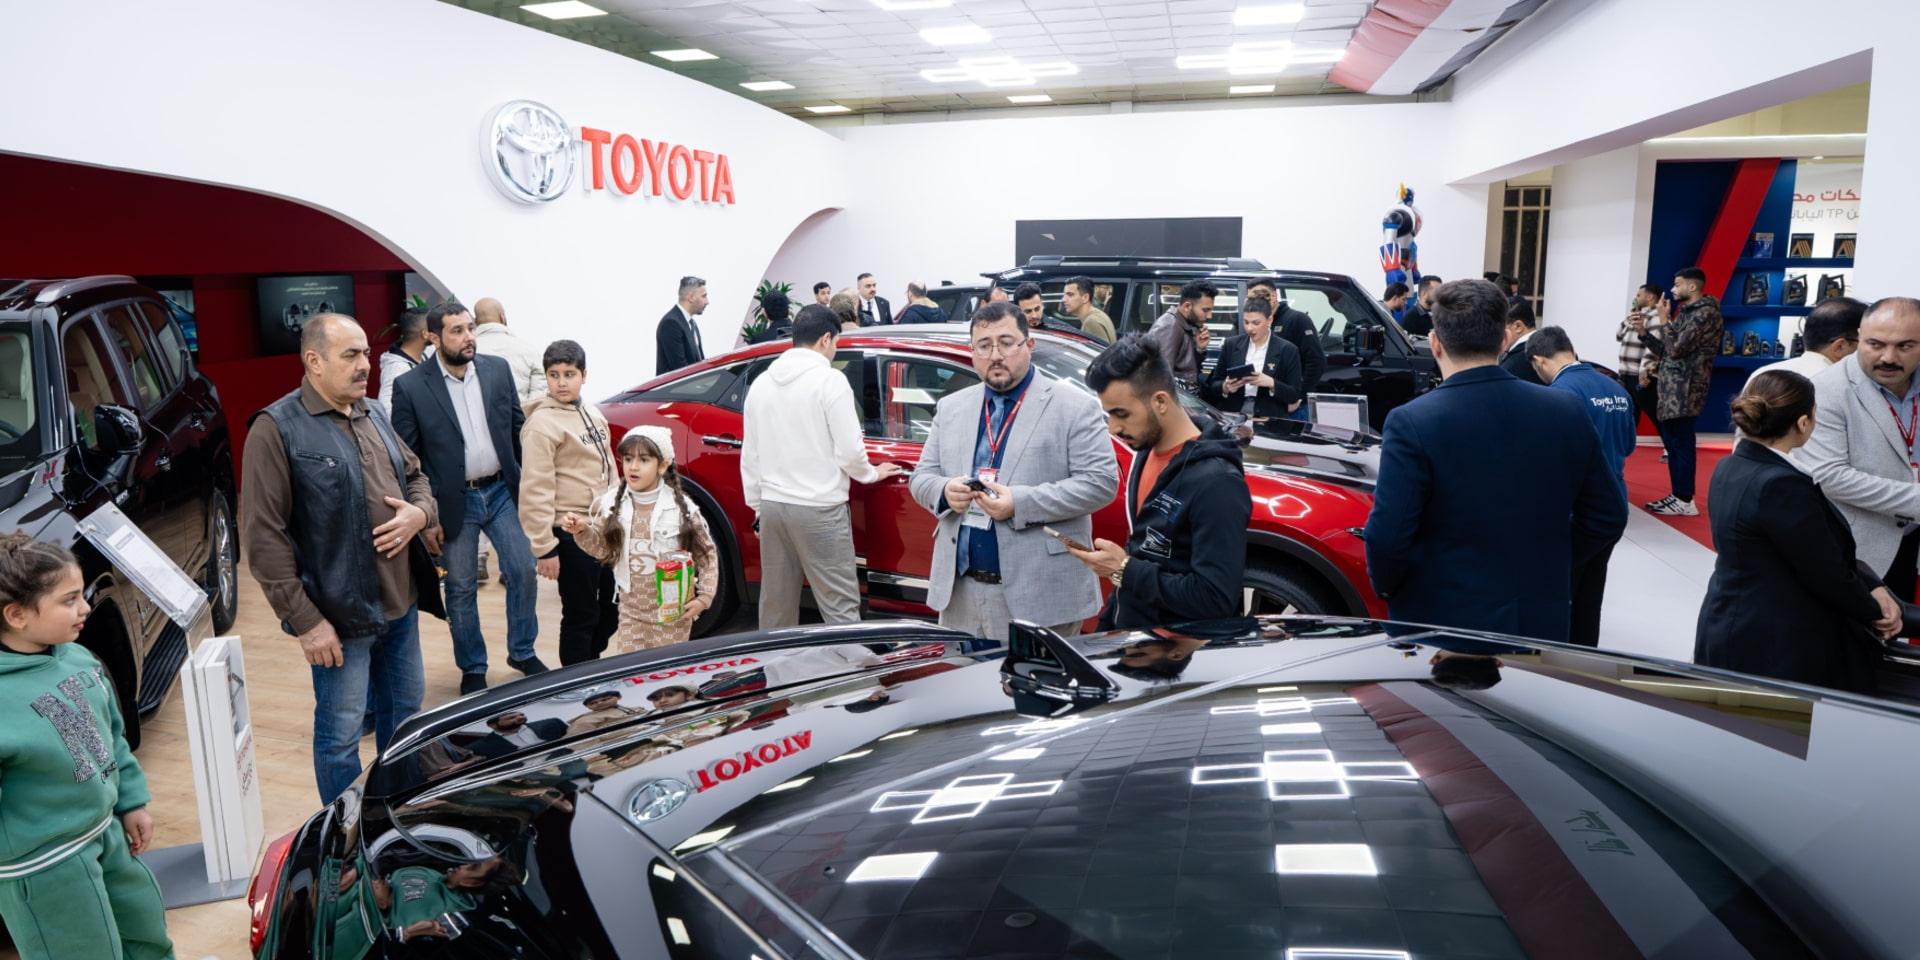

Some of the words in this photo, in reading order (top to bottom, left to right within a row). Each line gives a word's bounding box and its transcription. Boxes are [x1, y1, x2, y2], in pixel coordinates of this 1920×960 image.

[580, 126, 736, 205] TOYOTA
[1820, 188, 1861, 202] كات
[1827, 209, 1844, 219] TP
[1846, 209, 1860, 221] ن
[623, 657, 760, 686] TOYOTA
